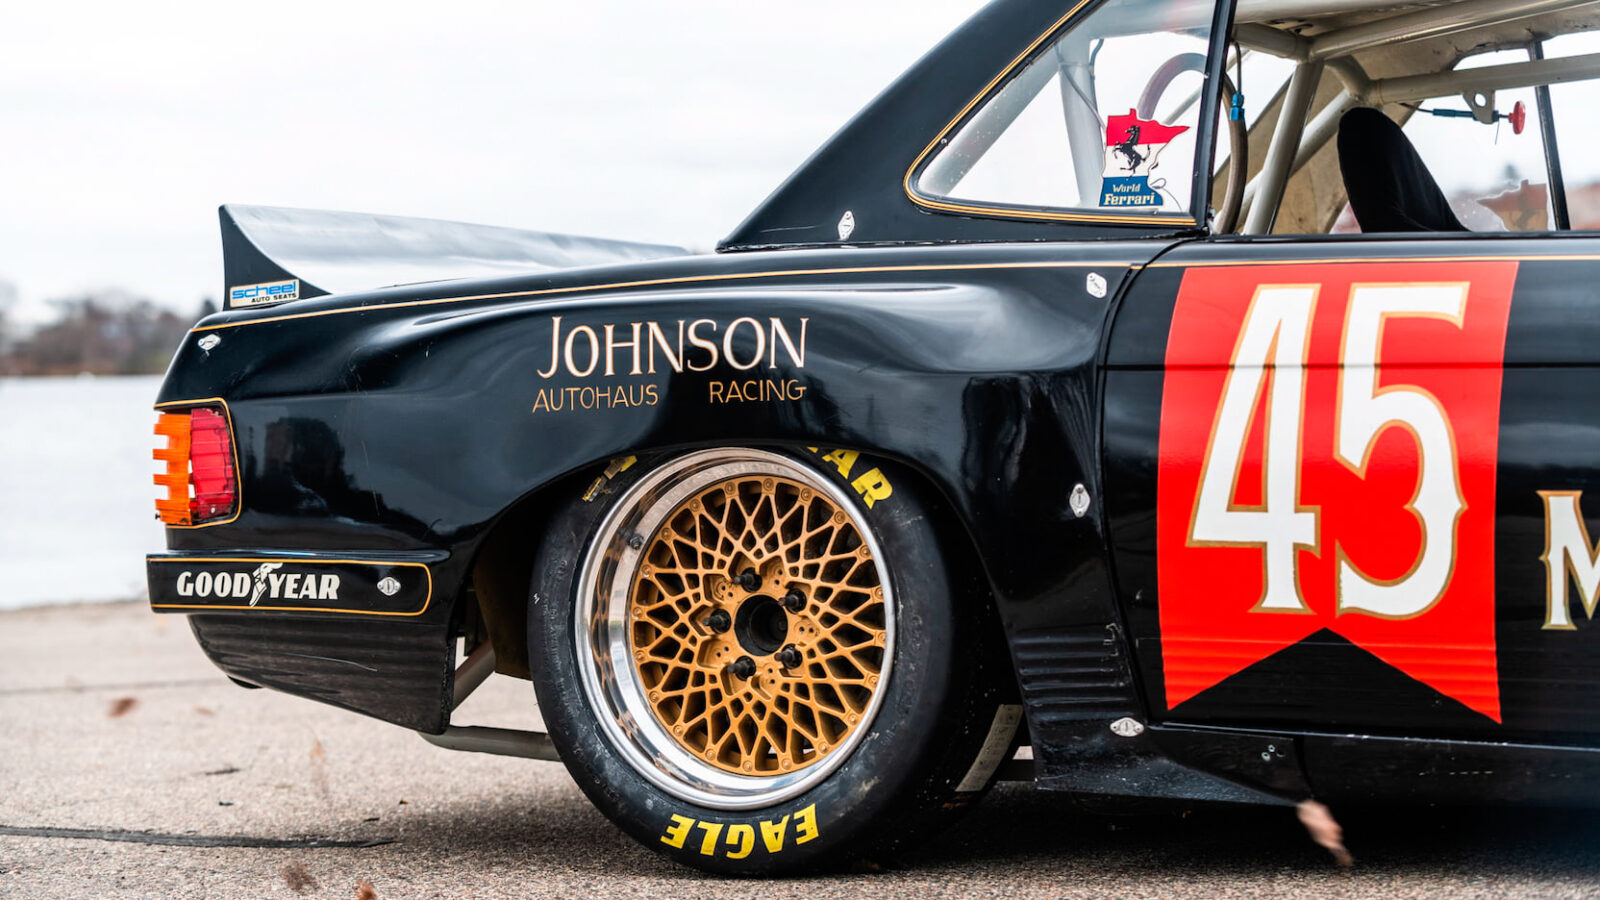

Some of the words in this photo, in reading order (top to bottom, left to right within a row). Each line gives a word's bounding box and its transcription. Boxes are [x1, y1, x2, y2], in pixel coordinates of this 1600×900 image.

[1103, 192, 1155, 205] Ferrari
[1112, 184, 1141, 192] World
[232, 281, 296, 299] scheel
[536, 315, 810, 379] JOHNSON
[531, 384, 660, 414] AUTOHAUS
[708, 379, 808, 405] RACING
[1184, 281, 1471, 621] 45
[806, 446, 893, 510] AR
[660, 803, 822, 860] EAGLE
